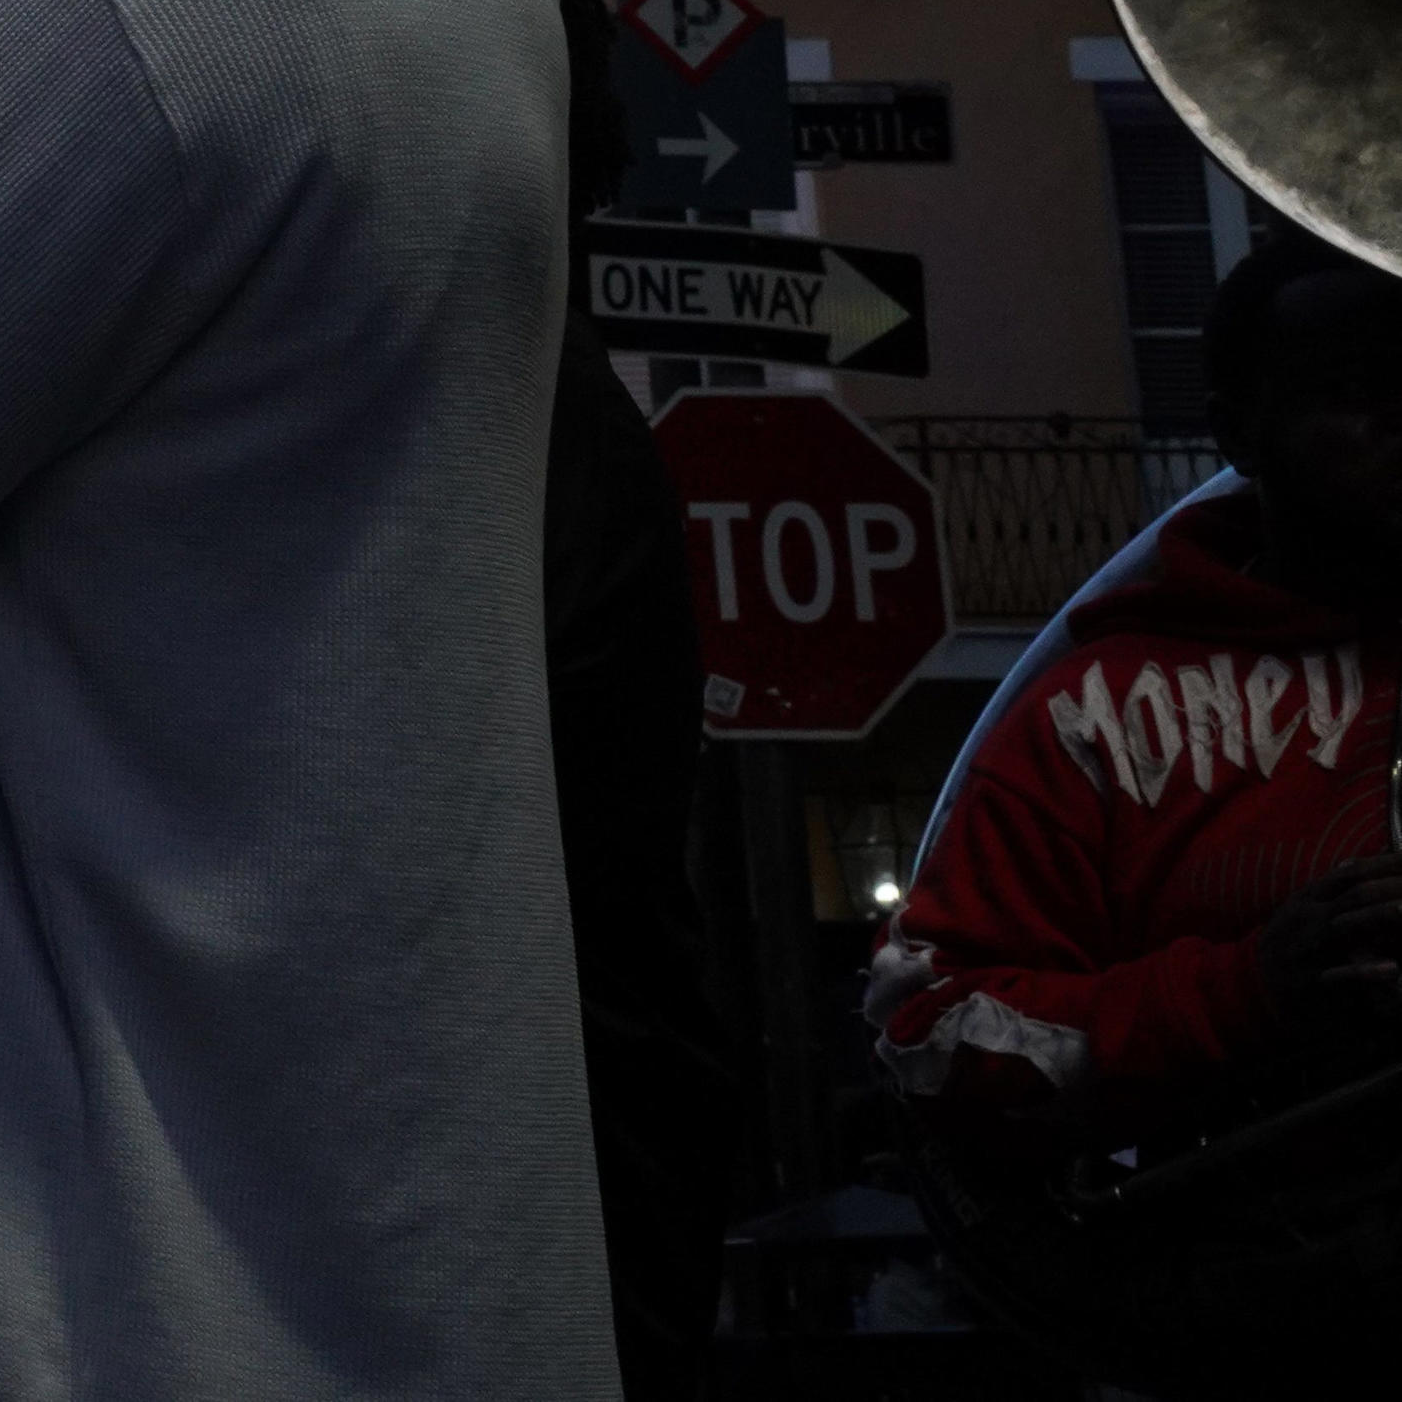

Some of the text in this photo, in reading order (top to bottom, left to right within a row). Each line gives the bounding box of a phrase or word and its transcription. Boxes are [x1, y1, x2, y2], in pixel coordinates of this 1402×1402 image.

[797, 108, 940, 152] rville
[601, 263, 822, 327] ONE WAY
[686, 499, 919, 626] TOP
